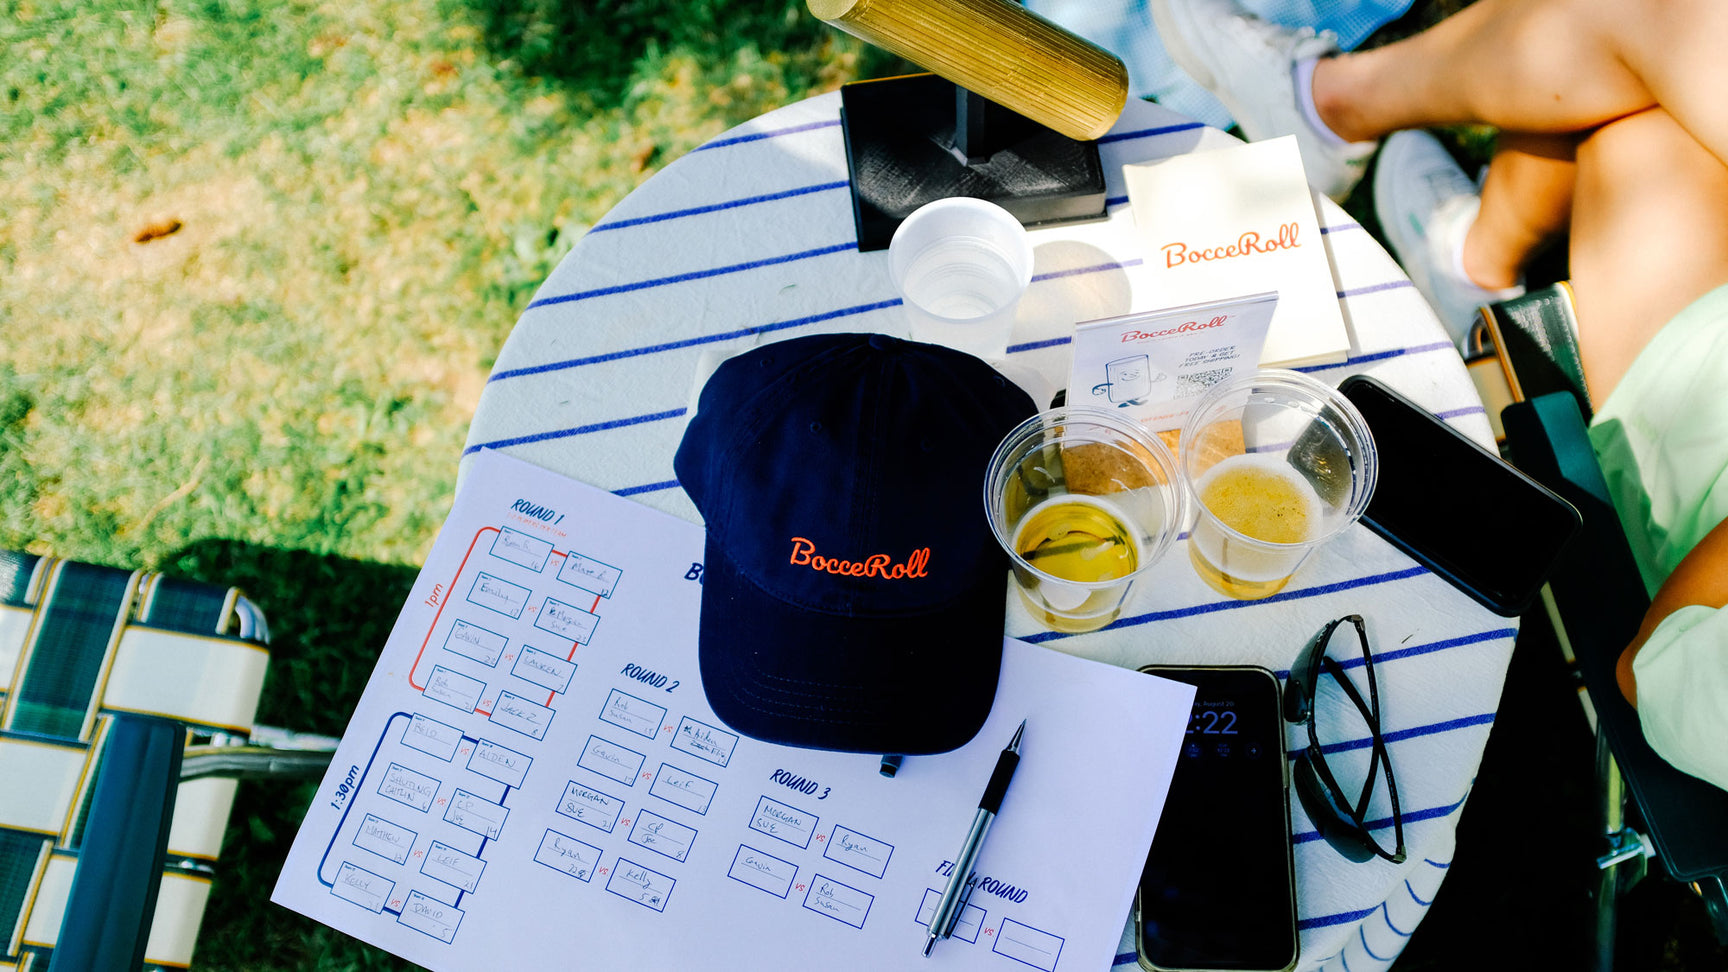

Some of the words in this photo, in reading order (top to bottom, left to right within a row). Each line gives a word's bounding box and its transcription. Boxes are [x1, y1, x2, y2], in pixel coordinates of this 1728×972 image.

[1160, 221, 1302, 268] BocceRoll
[1120, 314, 1229, 344] BocceRoll
[510, 498, 555, 522] ROUND
[554, 514, 565, 525] 1
[789, 536, 931, 580] BocceRoll
[424, 583, 444, 608] 1pm
[620, 662, 668, 689] ROUND
[666, 680, 680, 693] 2
[1186, 711, 1238, 734] :22
[330, 764, 361, 810] 1:30pm
[769, 768, 819, 795] ROUND
[818, 787, 831, 800] 3
[978, 876, 1029, 904] ROUND
